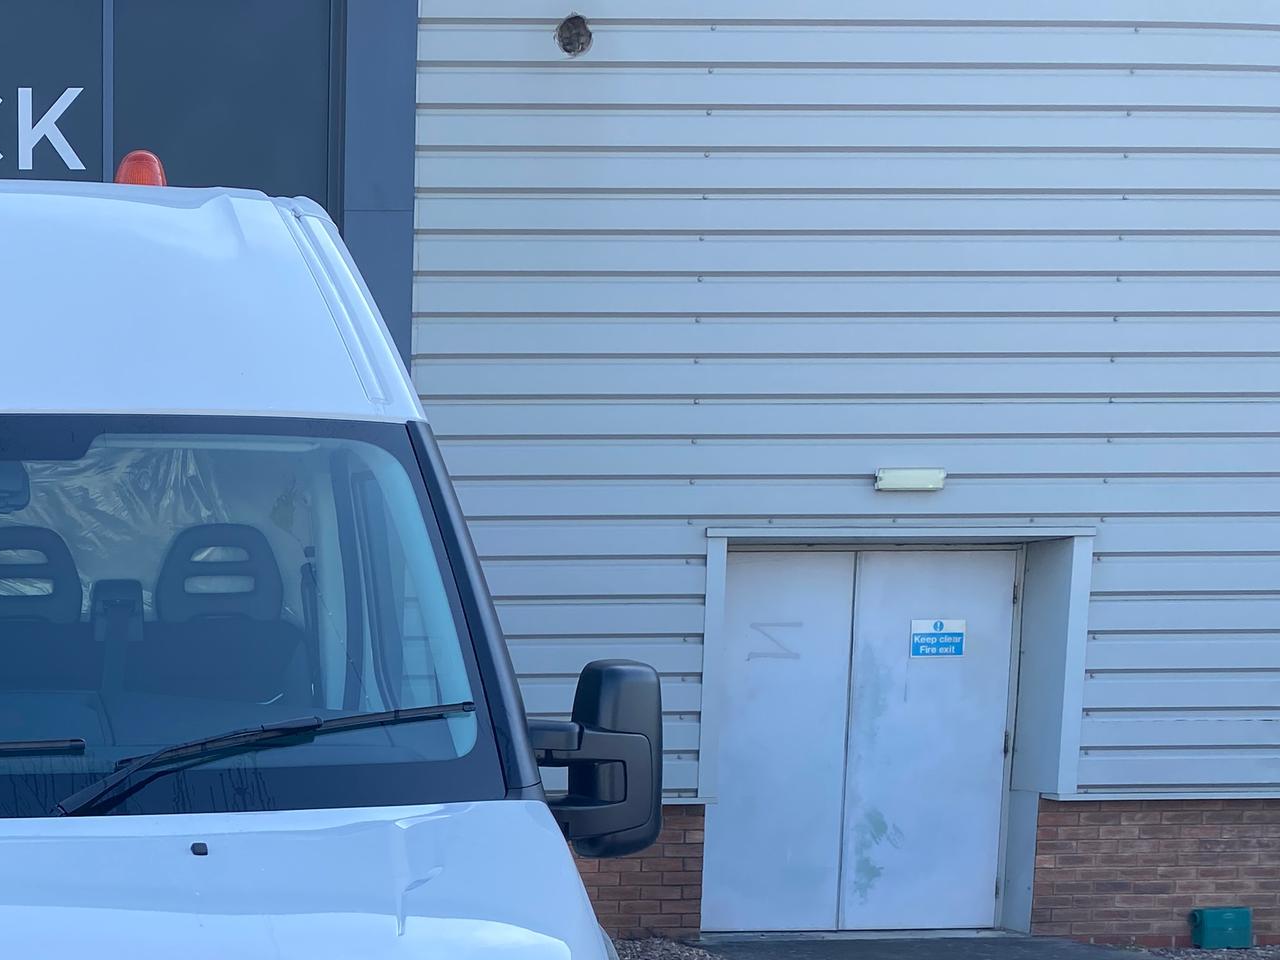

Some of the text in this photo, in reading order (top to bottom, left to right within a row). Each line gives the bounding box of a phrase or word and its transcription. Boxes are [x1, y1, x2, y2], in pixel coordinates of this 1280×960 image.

[914, 635, 962, 645] Keep clear
[920, 645, 955, 654] Fire exit
